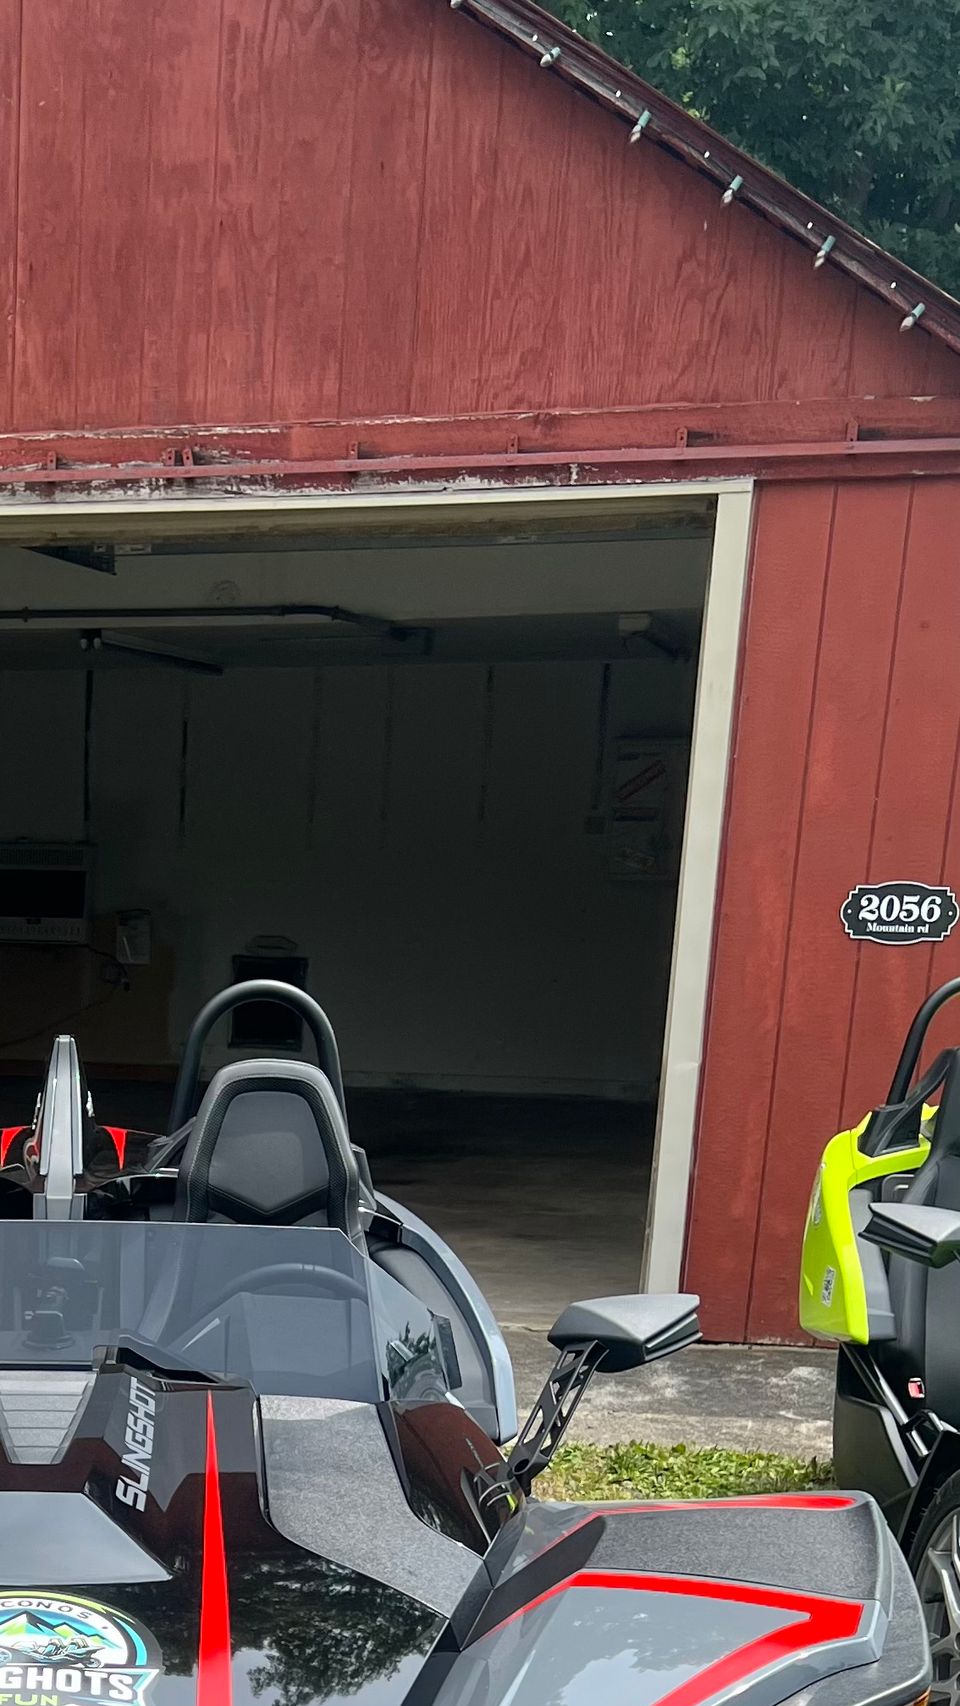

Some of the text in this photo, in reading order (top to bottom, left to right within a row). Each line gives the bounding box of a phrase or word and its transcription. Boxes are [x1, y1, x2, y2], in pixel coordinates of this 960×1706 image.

[858, 894, 942, 922] 2056
[866, 922, 930, 934] Mountain rd
[115, 1376, 157, 1513] SLINGSHOT
